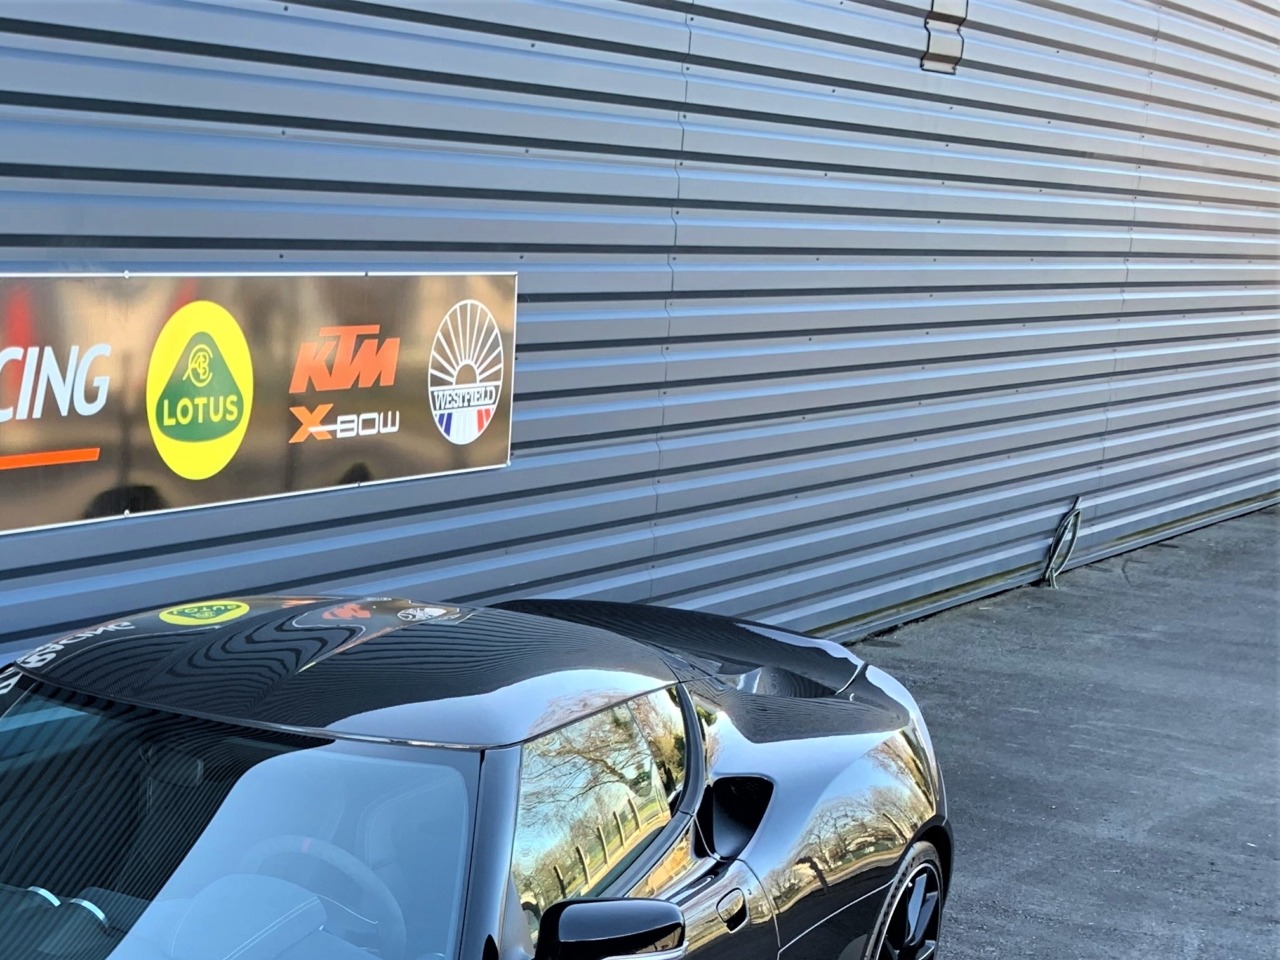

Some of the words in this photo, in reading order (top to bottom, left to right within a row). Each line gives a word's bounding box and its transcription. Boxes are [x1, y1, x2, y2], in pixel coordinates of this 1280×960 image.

[289, 324, 400, 394] KTM
[163, 394, 238, 427] LOTUS
[433, 386, 496, 411] WESTFIELD
[289, 403, 400, 444] X-BOW
